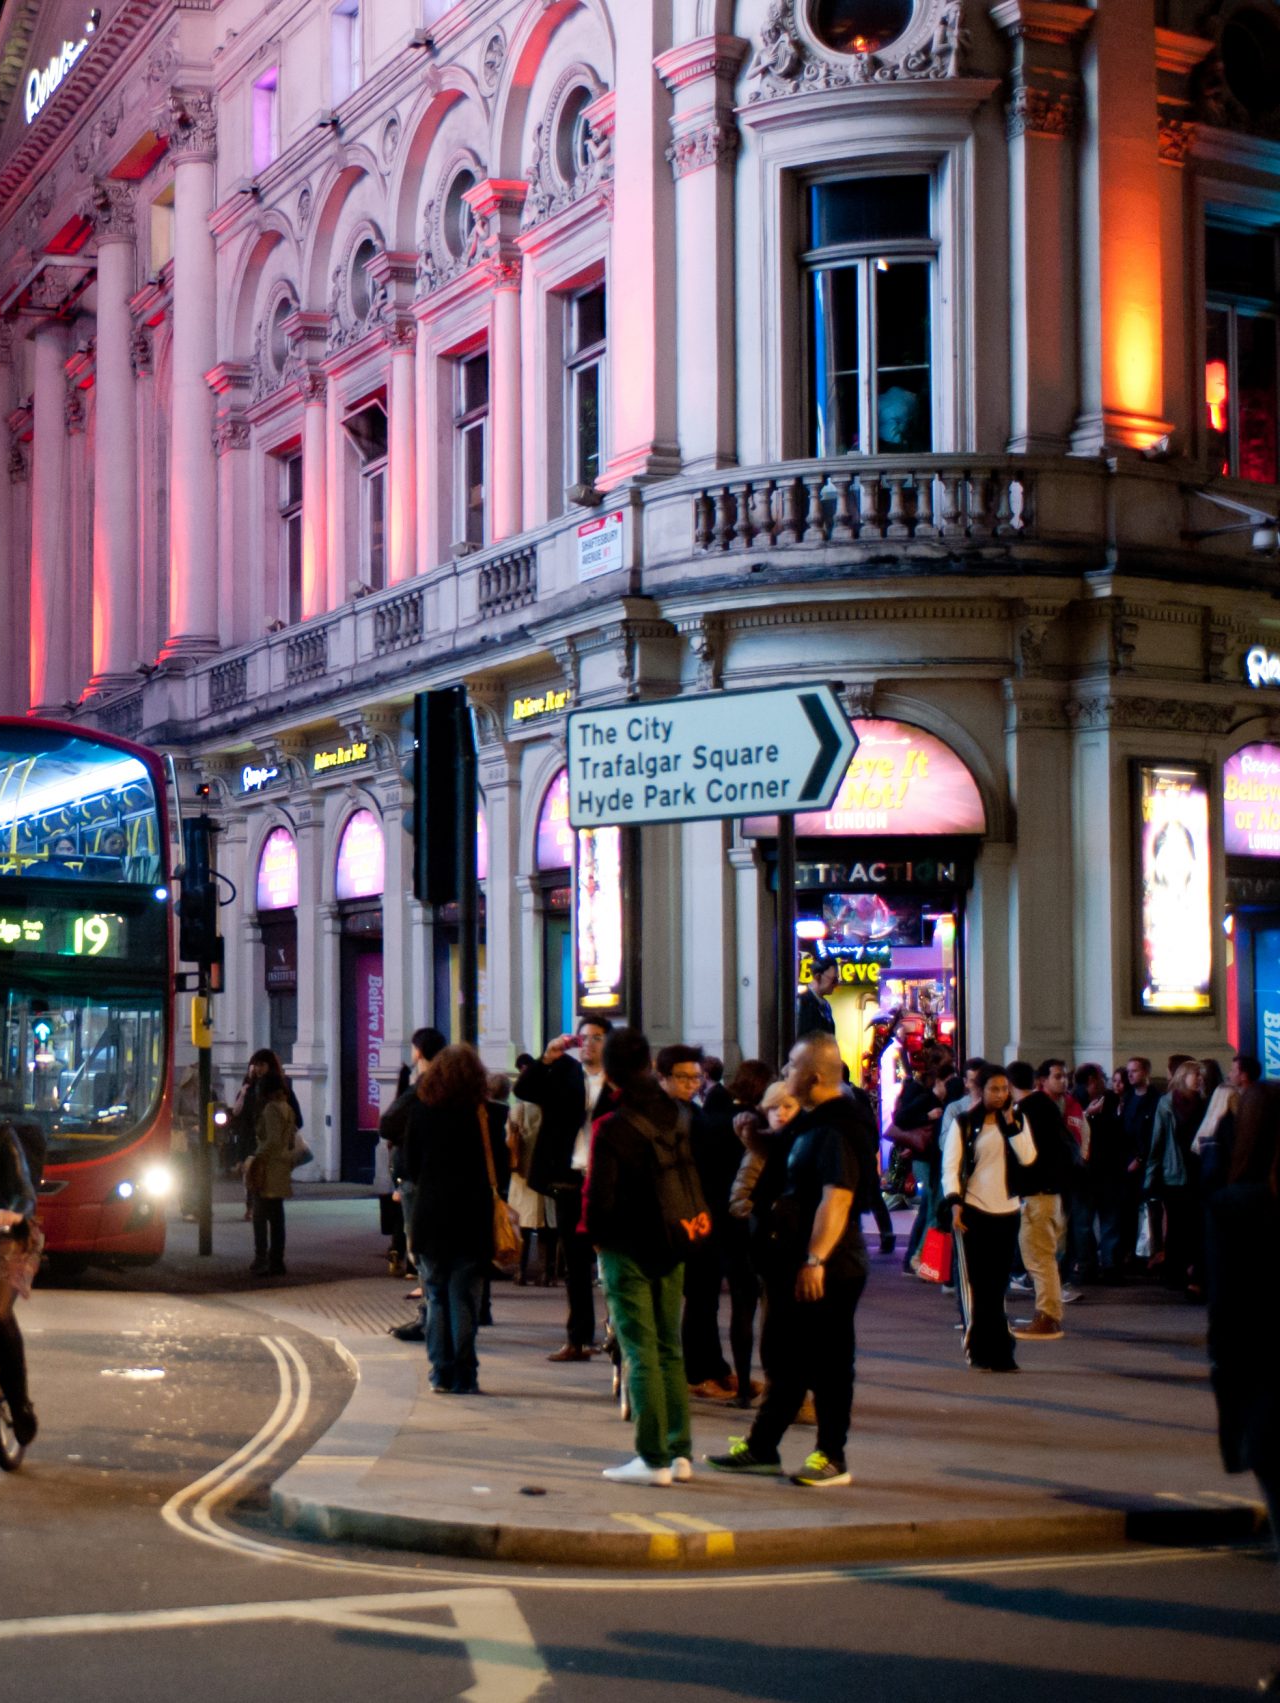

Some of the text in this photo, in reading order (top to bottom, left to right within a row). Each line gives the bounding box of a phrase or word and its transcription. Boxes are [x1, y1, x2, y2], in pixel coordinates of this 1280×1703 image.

[579, 717, 672, 746] The City
[579, 744, 779, 780] Trafalgar Square
[901, 750, 929, 778] It
[578, 778, 790, 817] Hyde Park Corner
[841, 778, 910, 810] Not!
[825, 811, 888, 830] LONDON
[1234, 810, 1254, 831] or
[795, 861, 955, 883] TTRACTION
[74, 917, 108, 955] 19
[799, 957, 880, 985] Bieve
[368, 975, 383, 1031] Believe
